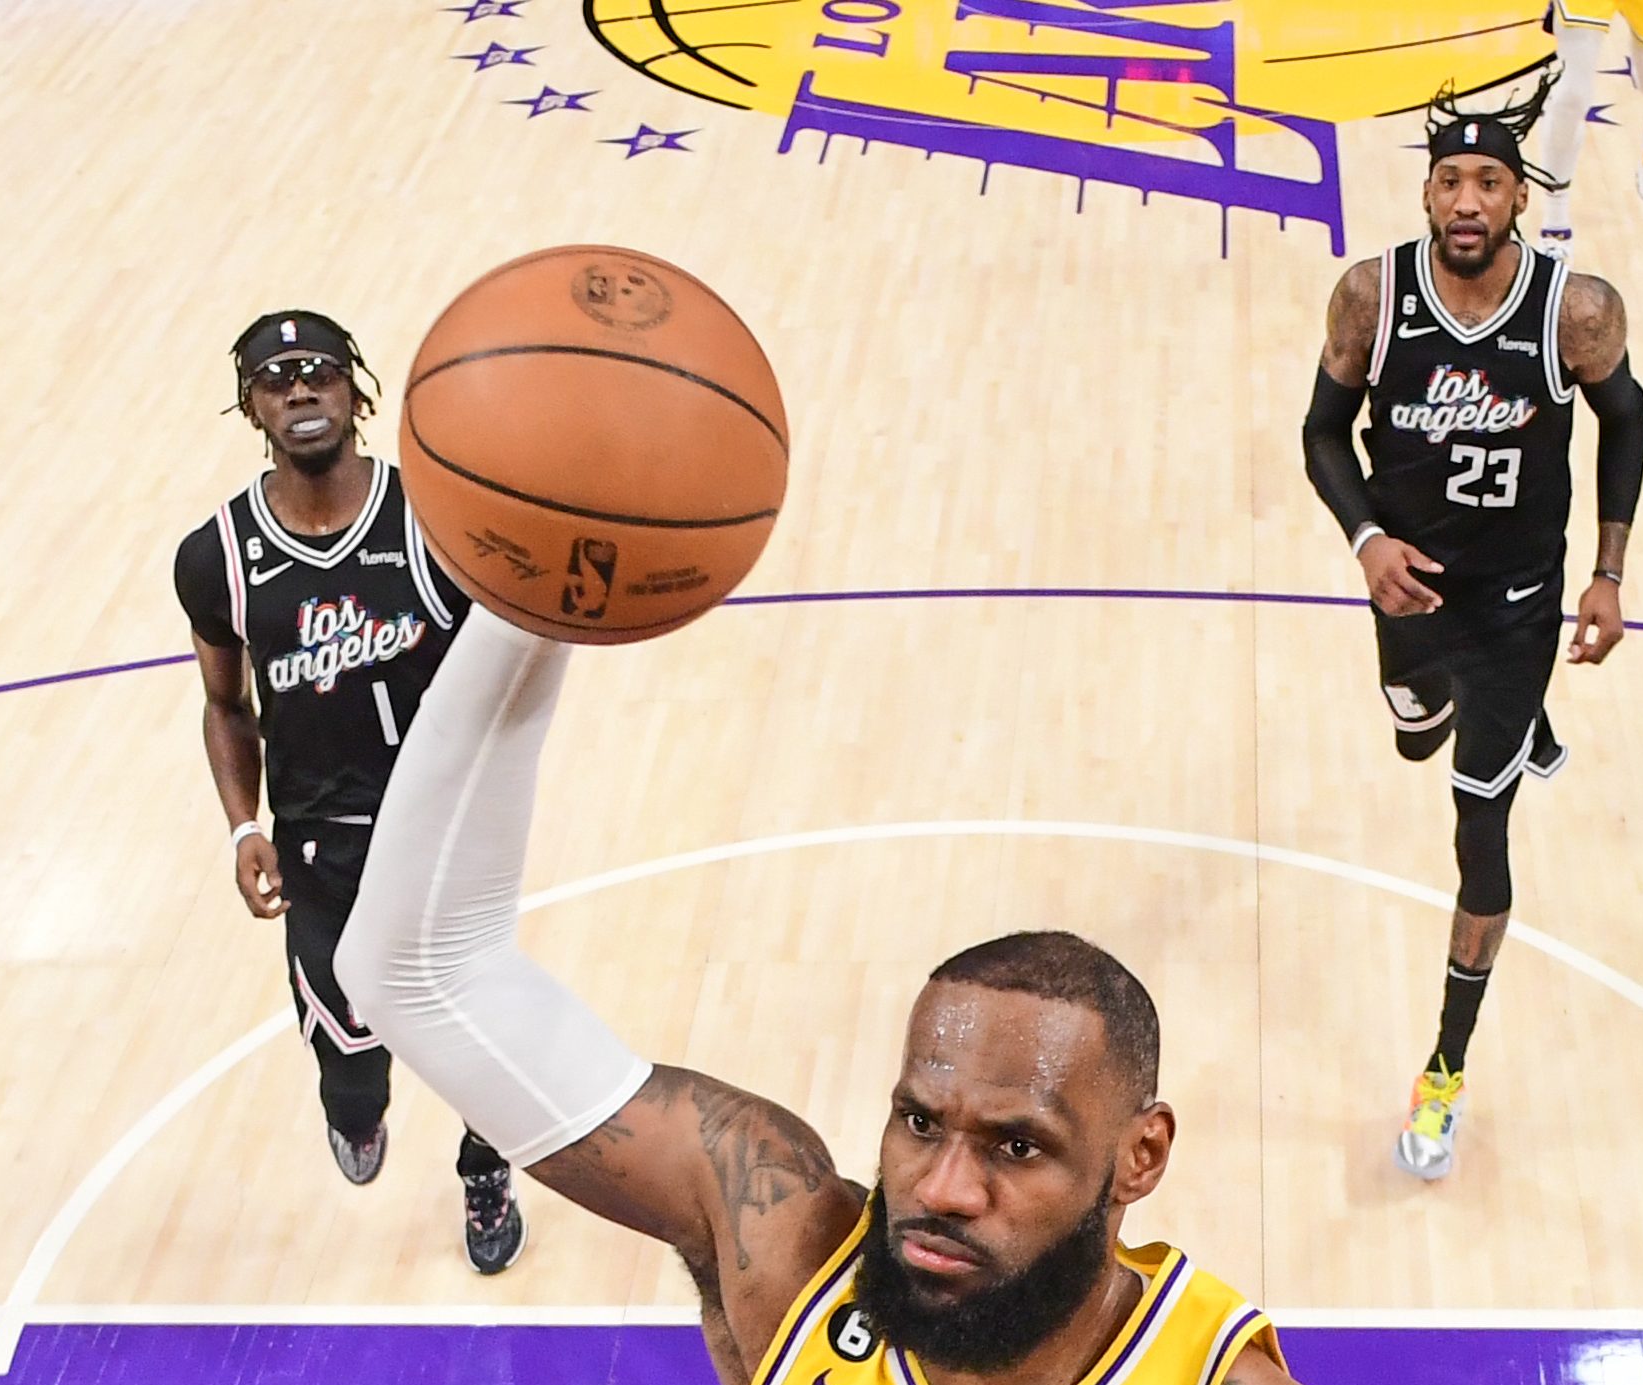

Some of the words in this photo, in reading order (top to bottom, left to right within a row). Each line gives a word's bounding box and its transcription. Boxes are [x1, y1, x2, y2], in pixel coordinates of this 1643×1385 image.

[1402, 294, 1418, 316] 6
[1497, 334, 1539, 357] honey
[1425, 366, 1489, 404] los
[1390, 396, 1535, 443] angeles
[1445, 444, 1522, 508] 23
[246, 536, 264, 561] 6
[358, 548, 407, 567] honey
[299, 597, 366, 647] los
[267, 612, 424, 692] angeles
[372, 680, 400, 746] 1
[836, 1308, 873, 1357] 6
